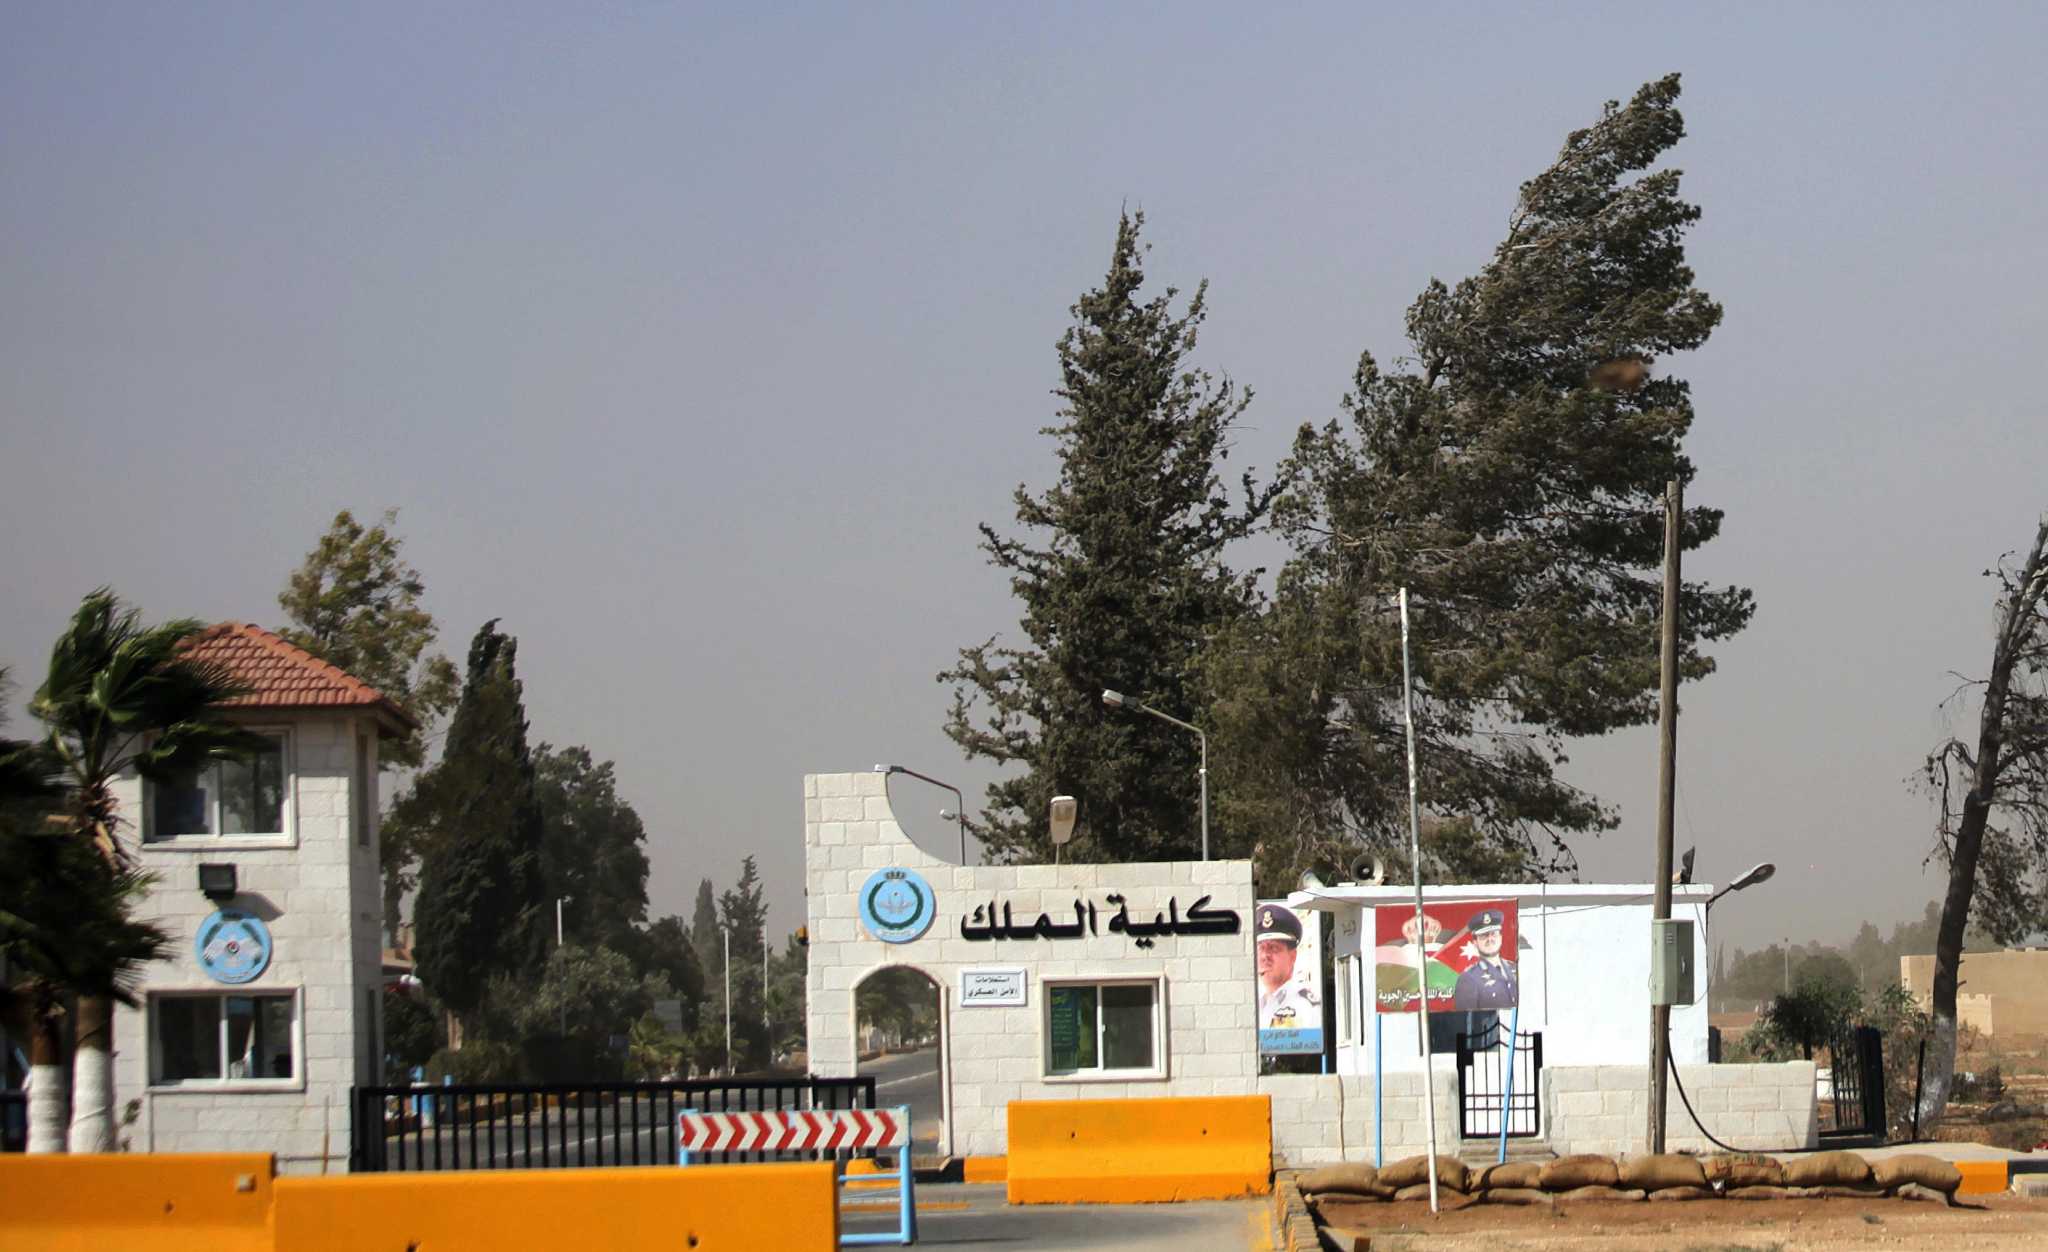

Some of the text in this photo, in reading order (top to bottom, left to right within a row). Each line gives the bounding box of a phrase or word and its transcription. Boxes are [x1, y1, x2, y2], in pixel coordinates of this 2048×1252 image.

[961, 894, 1241, 949] كلية الملك
[1378, 988, 1402, 1002] الجوية
[1438, 987, 1454, 1002] كلية
